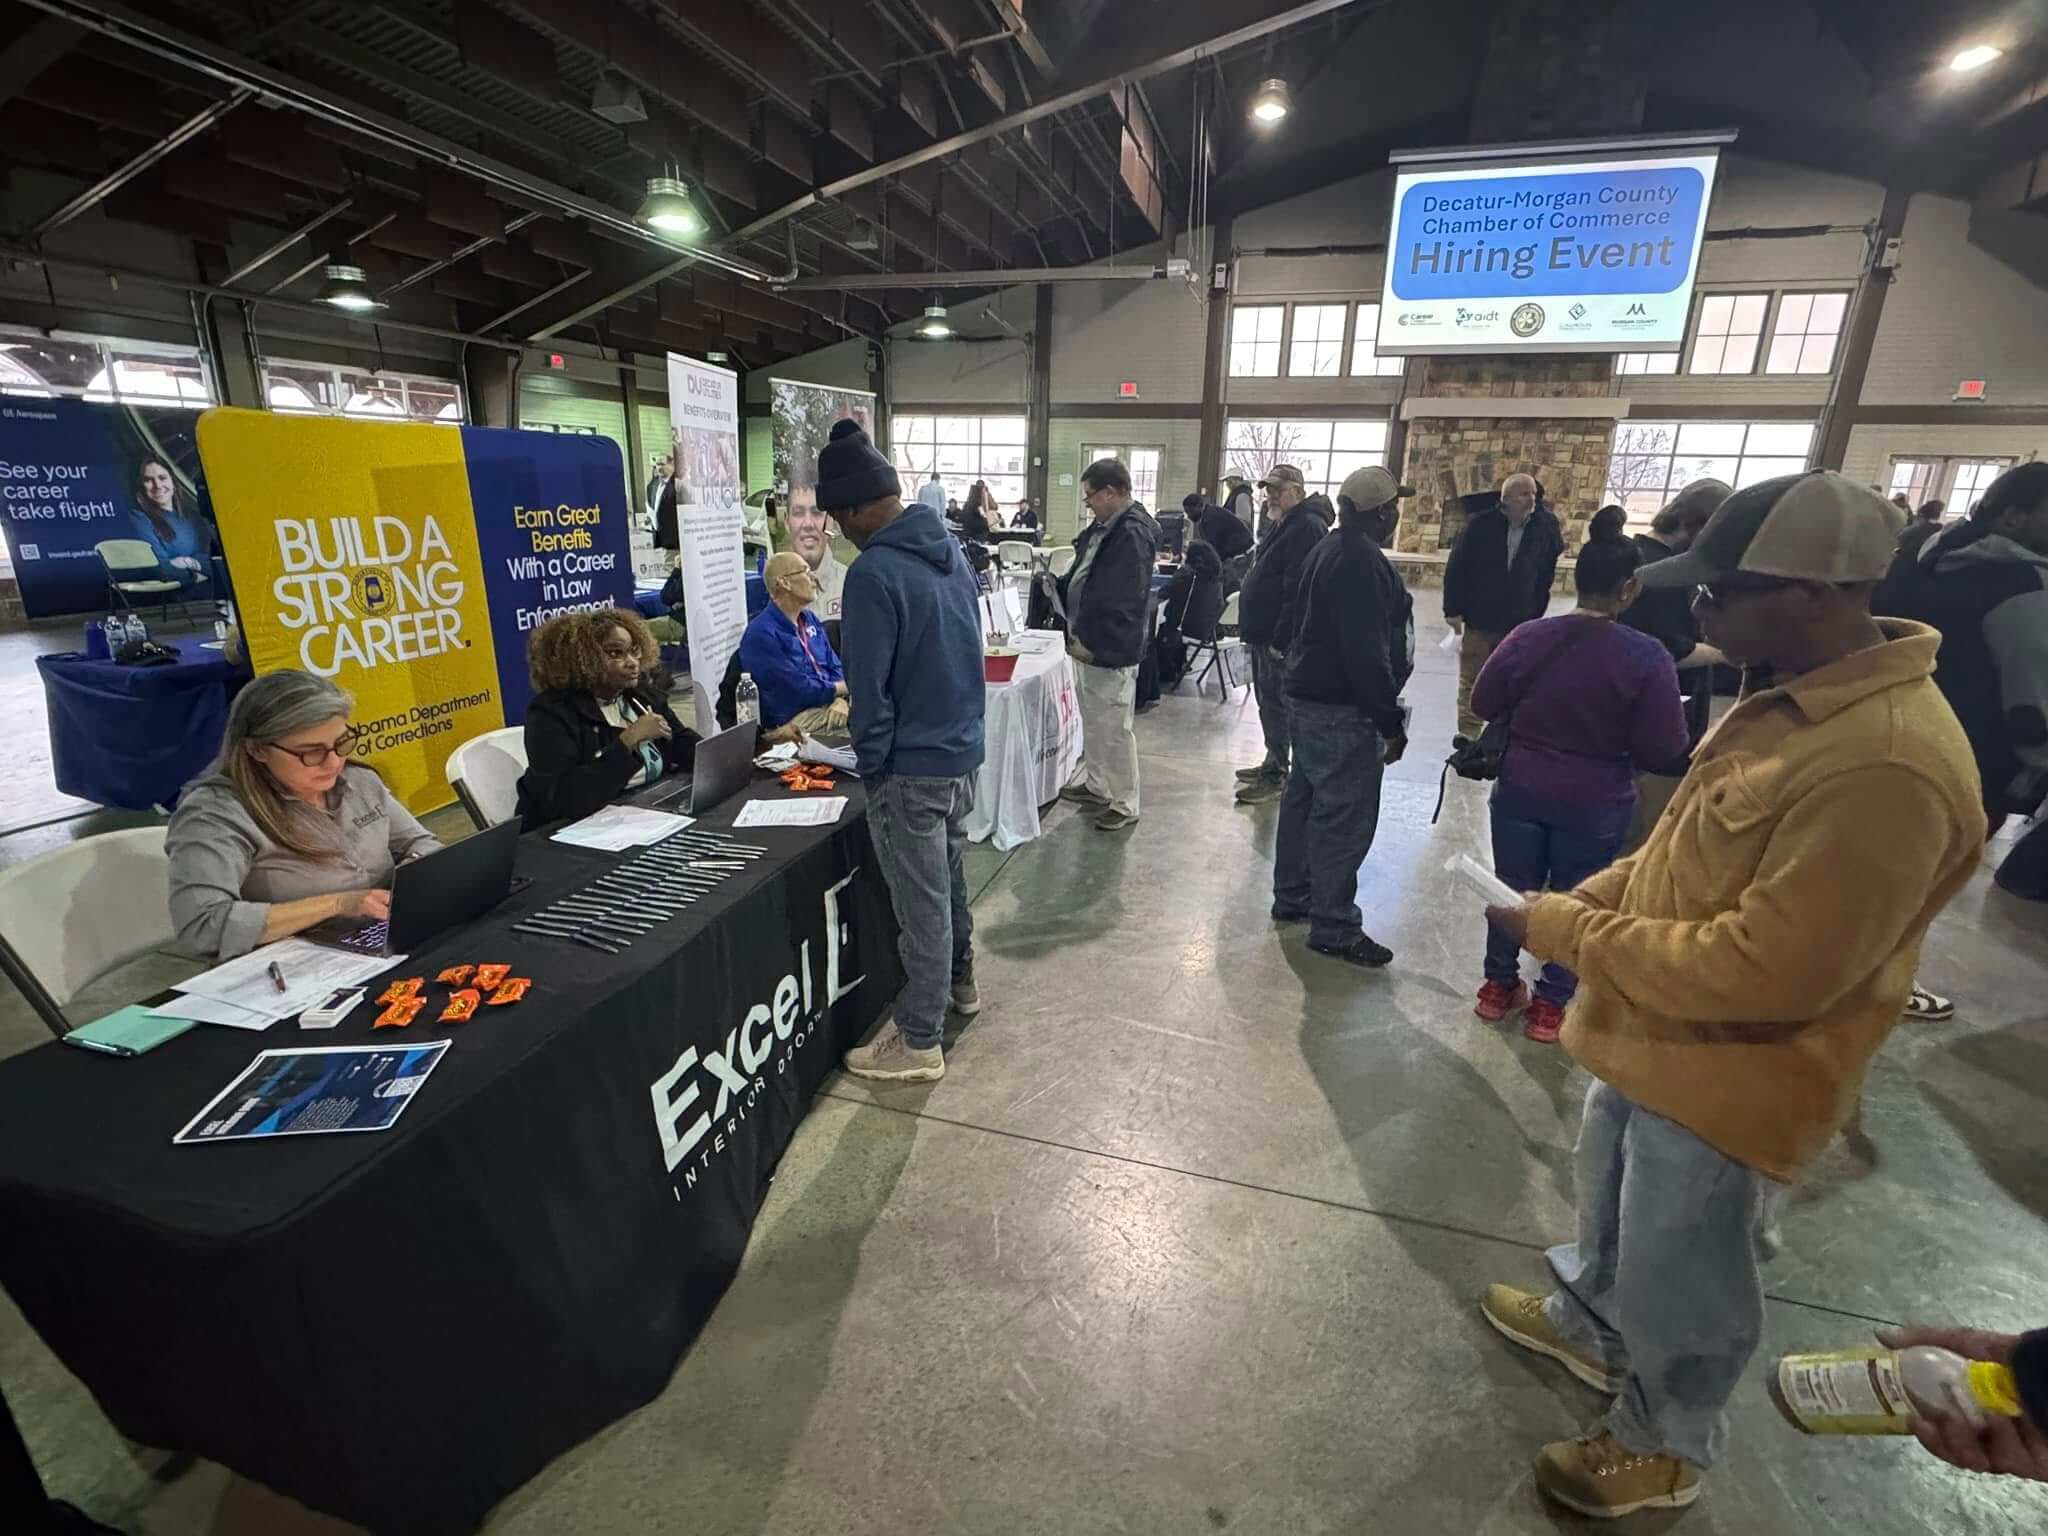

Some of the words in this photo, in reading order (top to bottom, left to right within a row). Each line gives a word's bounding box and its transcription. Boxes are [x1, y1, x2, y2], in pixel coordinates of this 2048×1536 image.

[1423, 190, 1591, 213] Decatur-Morgan
[1599, 185, 1679, 205] County
[1422, 214, 1516, 235] Chamber
[1523, 213, 1545, 230] of
[1550, 211, 1670, 230] Commerce
[1410, 240, 1538, 280] Hiring
[1548, 235, 1675, 270] Event
[0, 461, 38, 479] See
[42, 464, 88, 483] your
[3, 485, 70, 499] career
[8, 502, 56, 520] take
[60, 501, 116, 521] flight!
[514, 505, 554, 528] Earn
[556, 504, 601, 526] Great
[273, 516, 413, 572] BUILD
[420, 515, 452, 560] A
[531, 528, 593, 552] Benefits
[506, 556, 545, 581] With
[548, 561, 561, 576] a
[563, 553, 616, 575] Career
[542, 579, 558, 601] in
[560, 578, 592, 599] Law
[410, 689, 491, 722] Department
[357, 738, 372, 756] of
[375, 718, 454, 751] Corrections
[651, 939, 813, 1173] Excel
[673, 1076, 766, 1202] INTERIOR
